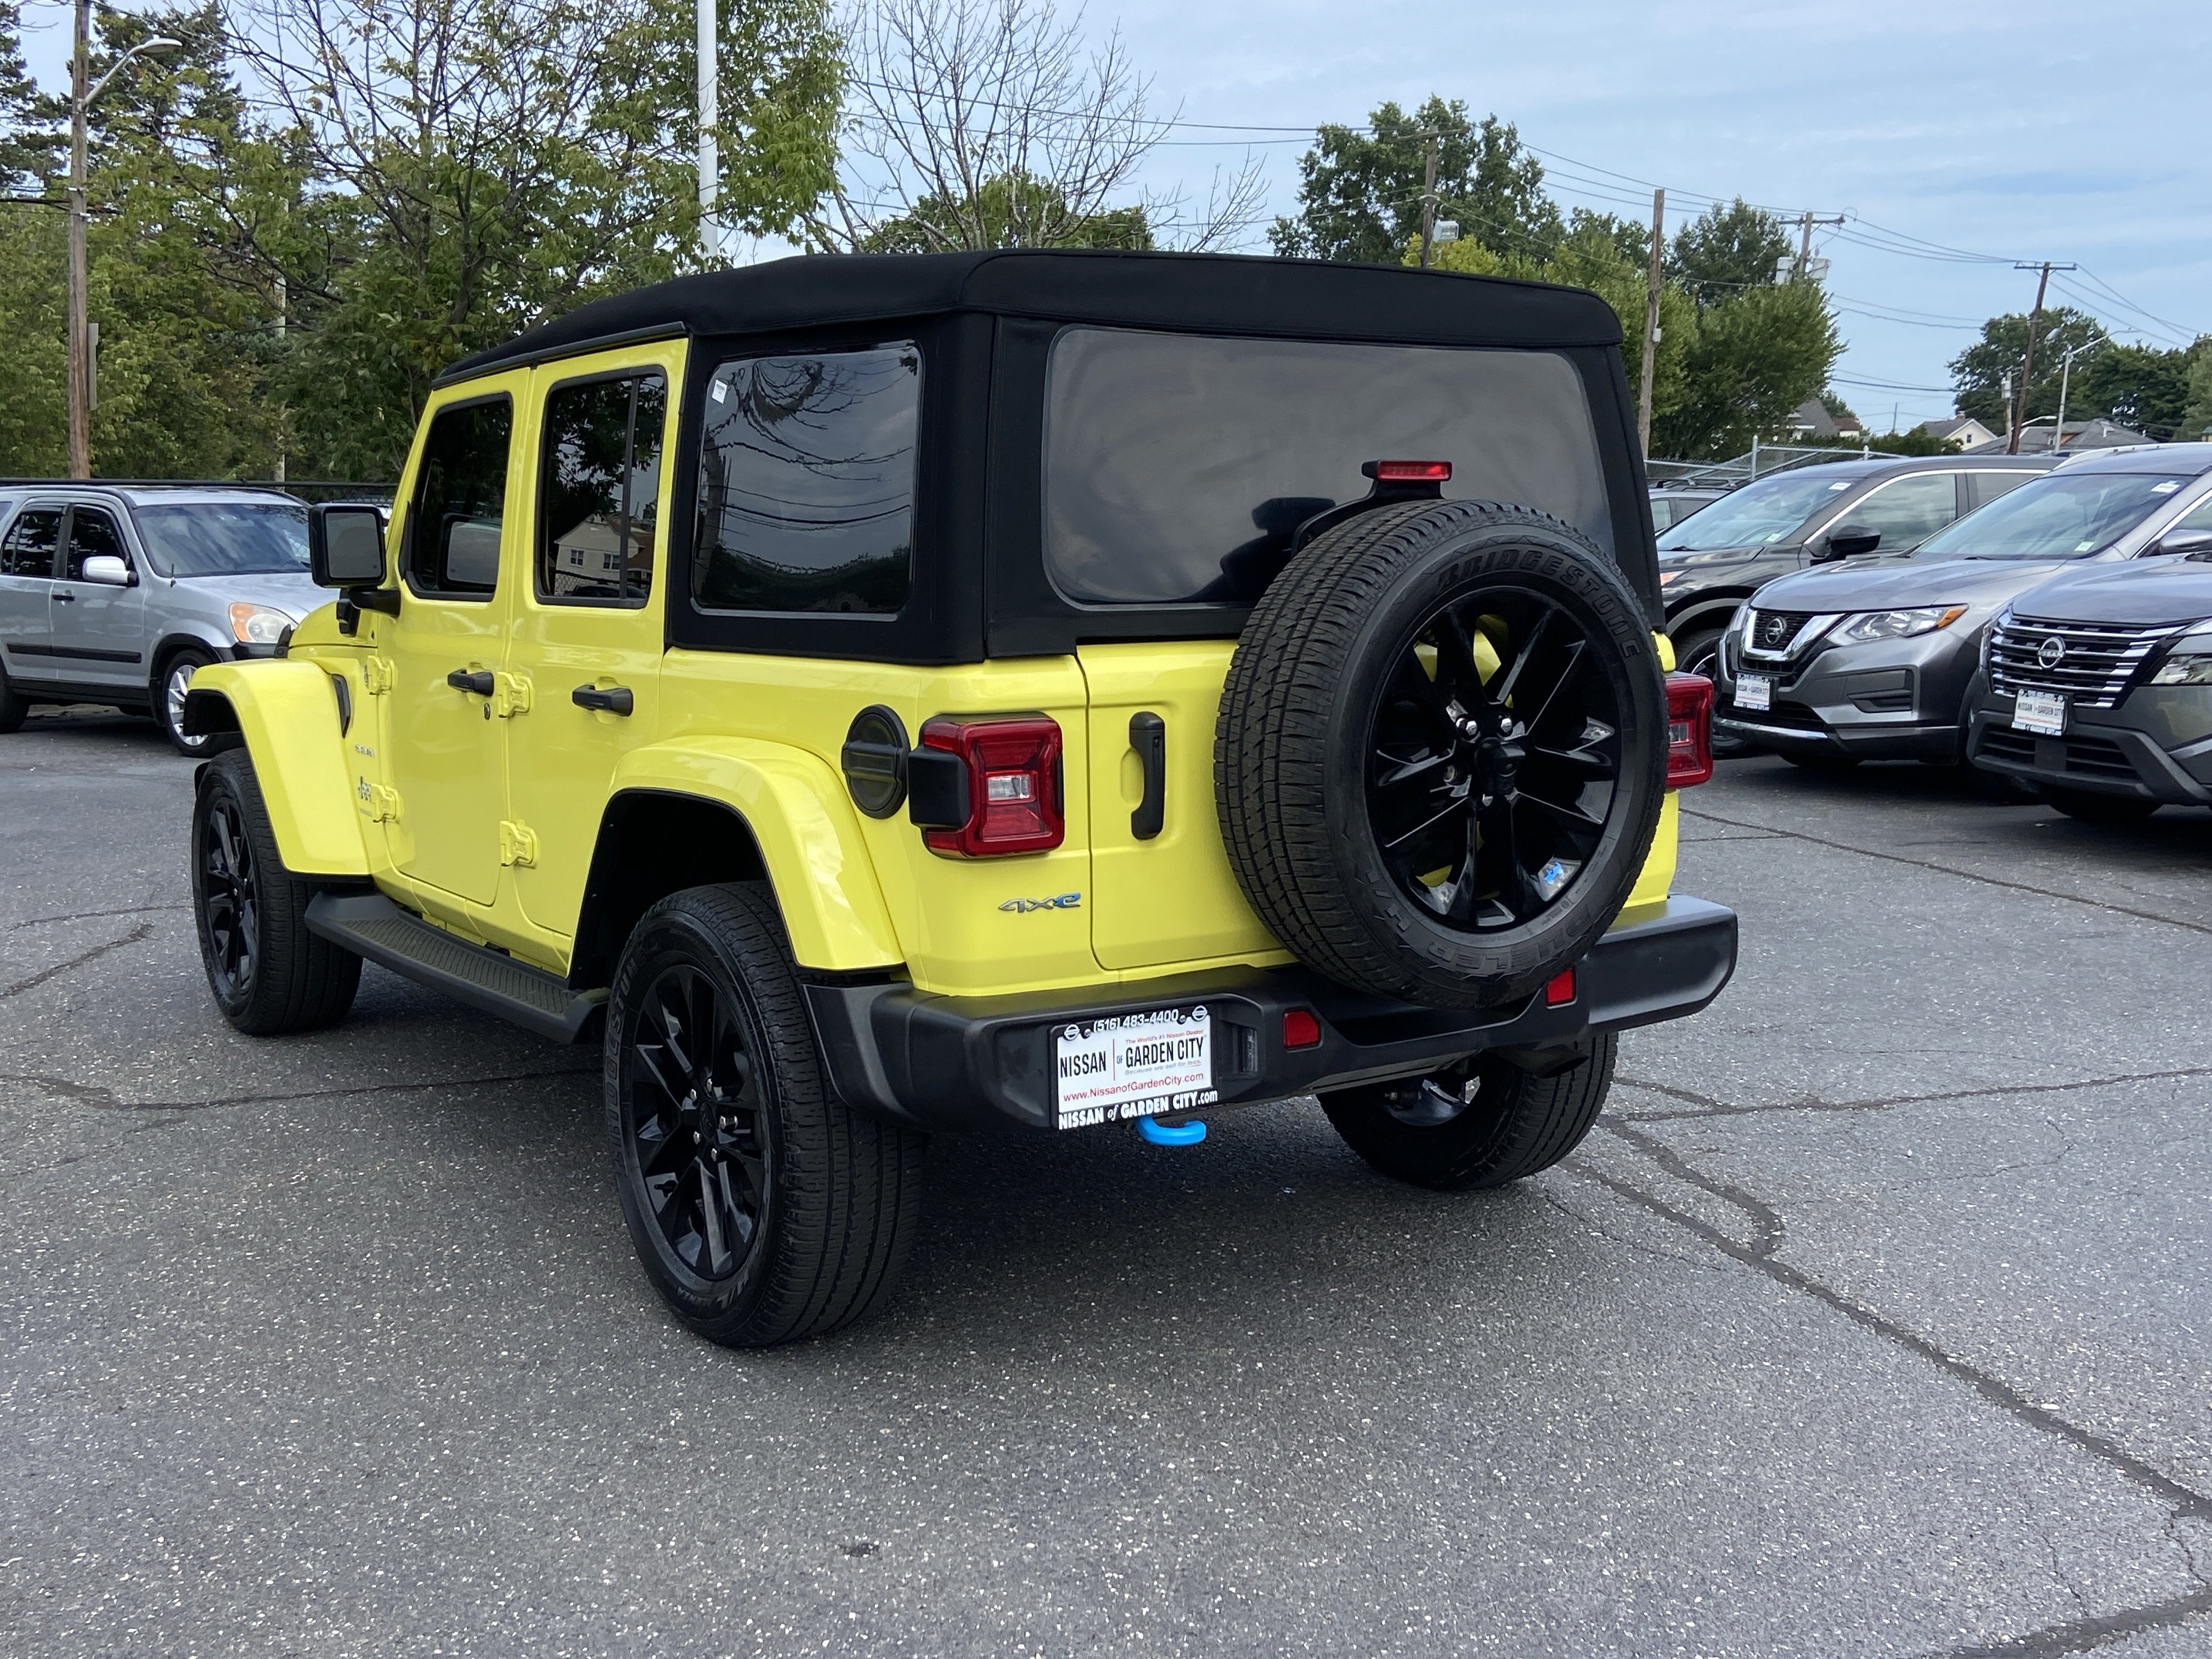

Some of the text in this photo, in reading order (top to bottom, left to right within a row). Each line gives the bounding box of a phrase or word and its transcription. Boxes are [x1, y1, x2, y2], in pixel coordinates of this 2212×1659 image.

[1435, 549, 1641, 658] BRIDGESTONE
[1093, 1009, 1179, 1033] (516) 483-4400
[1060, 1037, 1204, 1078] NISSAN OF GARDEN CITY
[1063, 1073, 1204, 1102] www.NissanofGardenCity.com
[1059, 1090, 1218, 1130] NISSAN of GARDEN CITY.com
